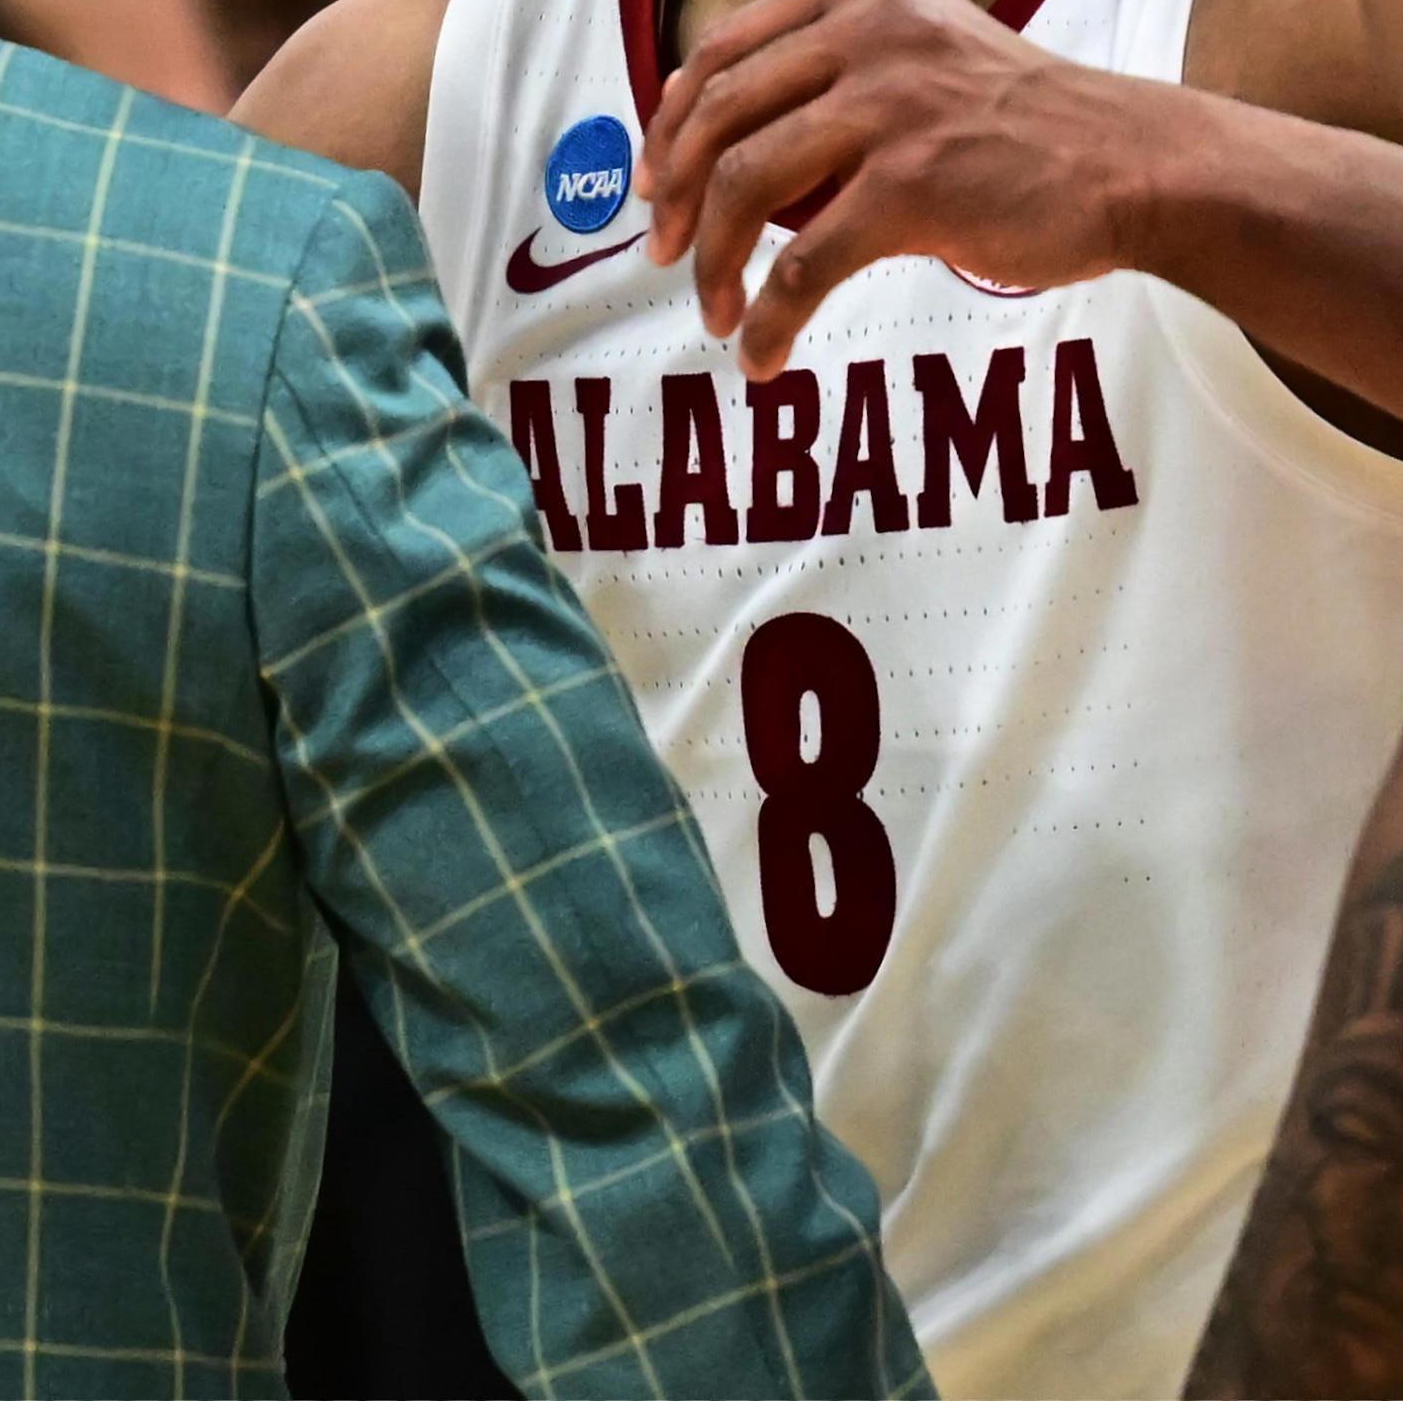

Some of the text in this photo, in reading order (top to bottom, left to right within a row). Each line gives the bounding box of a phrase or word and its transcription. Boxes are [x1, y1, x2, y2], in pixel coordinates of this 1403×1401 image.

[555, 167, 624, 203] NCAA
[510, 338, 1139, 552] ALABAMA
[741, 612, 897, 996] 8
